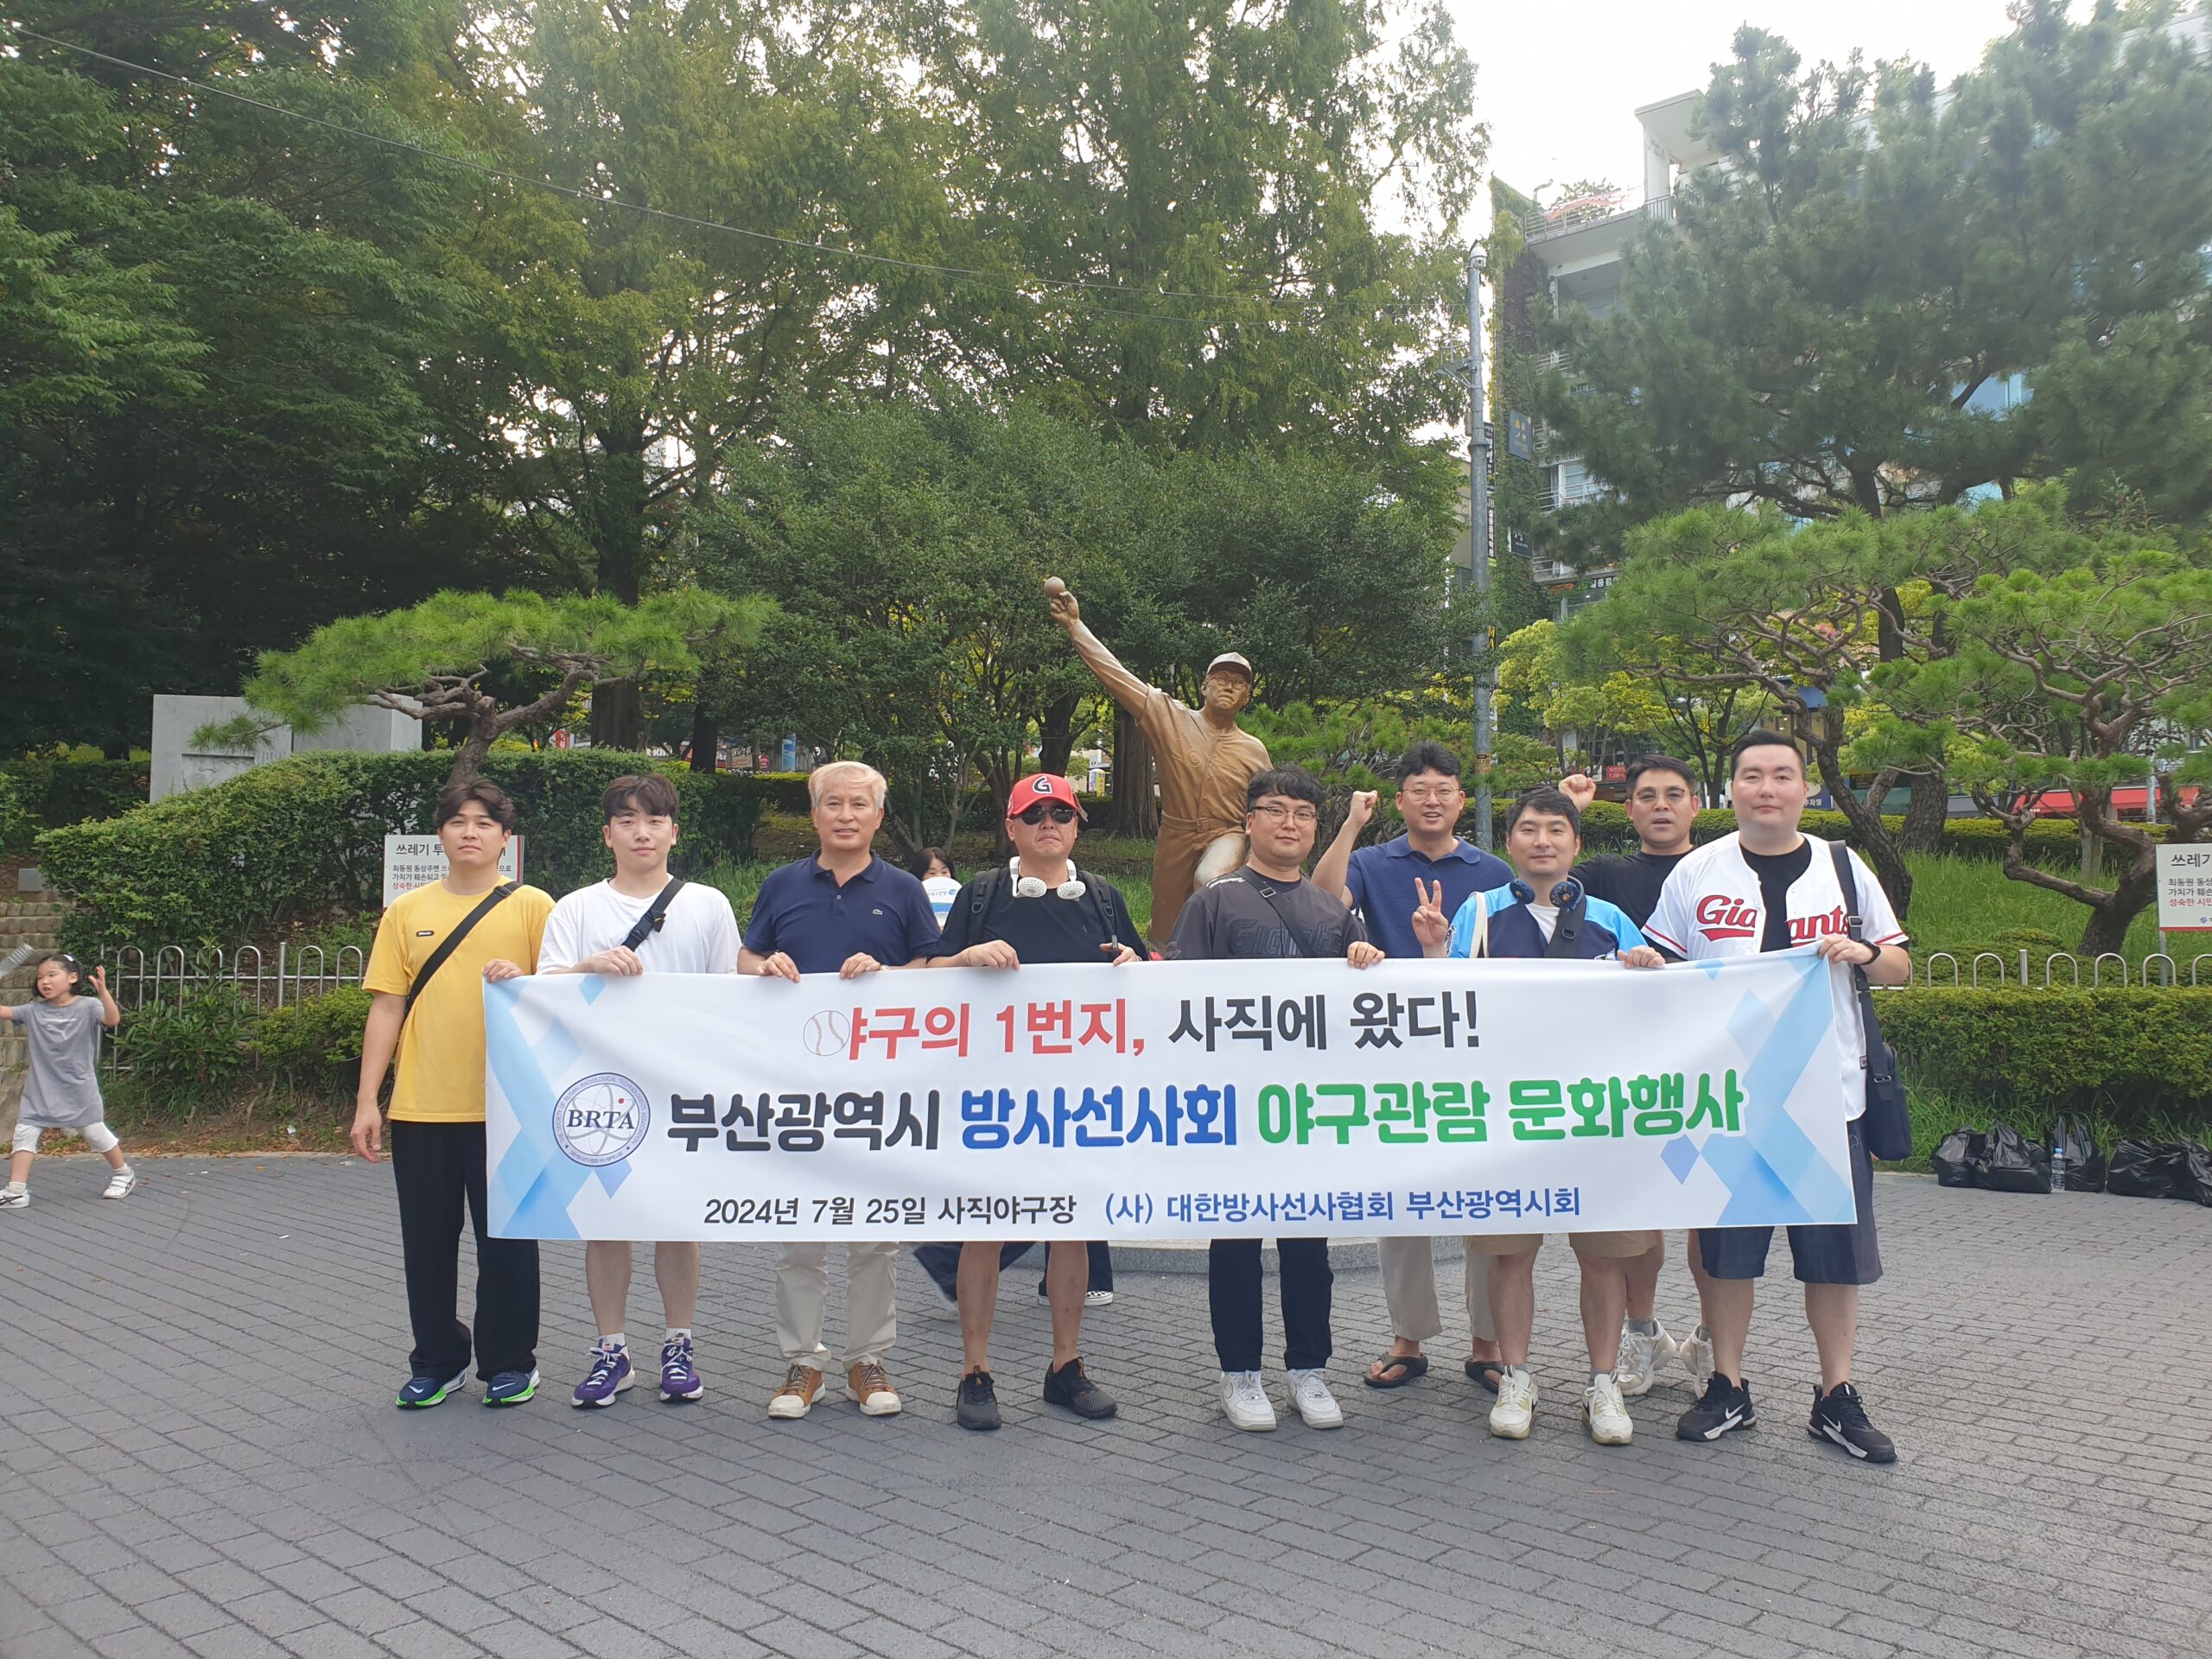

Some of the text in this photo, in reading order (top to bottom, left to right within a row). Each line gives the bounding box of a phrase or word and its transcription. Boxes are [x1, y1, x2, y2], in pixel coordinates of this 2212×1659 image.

[396, 843, 429, 856] 쓰레기
[2168, 878, 2195, 887] 최동원
[2168, 887, 2195, 897] 가치가
[2170, 898, 2195, 907] 성숙한
[804, 990, 1480, 1060] 야구의 1번지, 사직에 왔다!
[566, 1109, 636, 1129] BRTA
[667, 1069, 1745, 1153] 부산광역시 방사선사회 야구관람 문화행사
[703, 1186, 1580, 1225] 2024년 7월 25일 사직야구장 (사) 대한방사선사협회 부산광역시회
